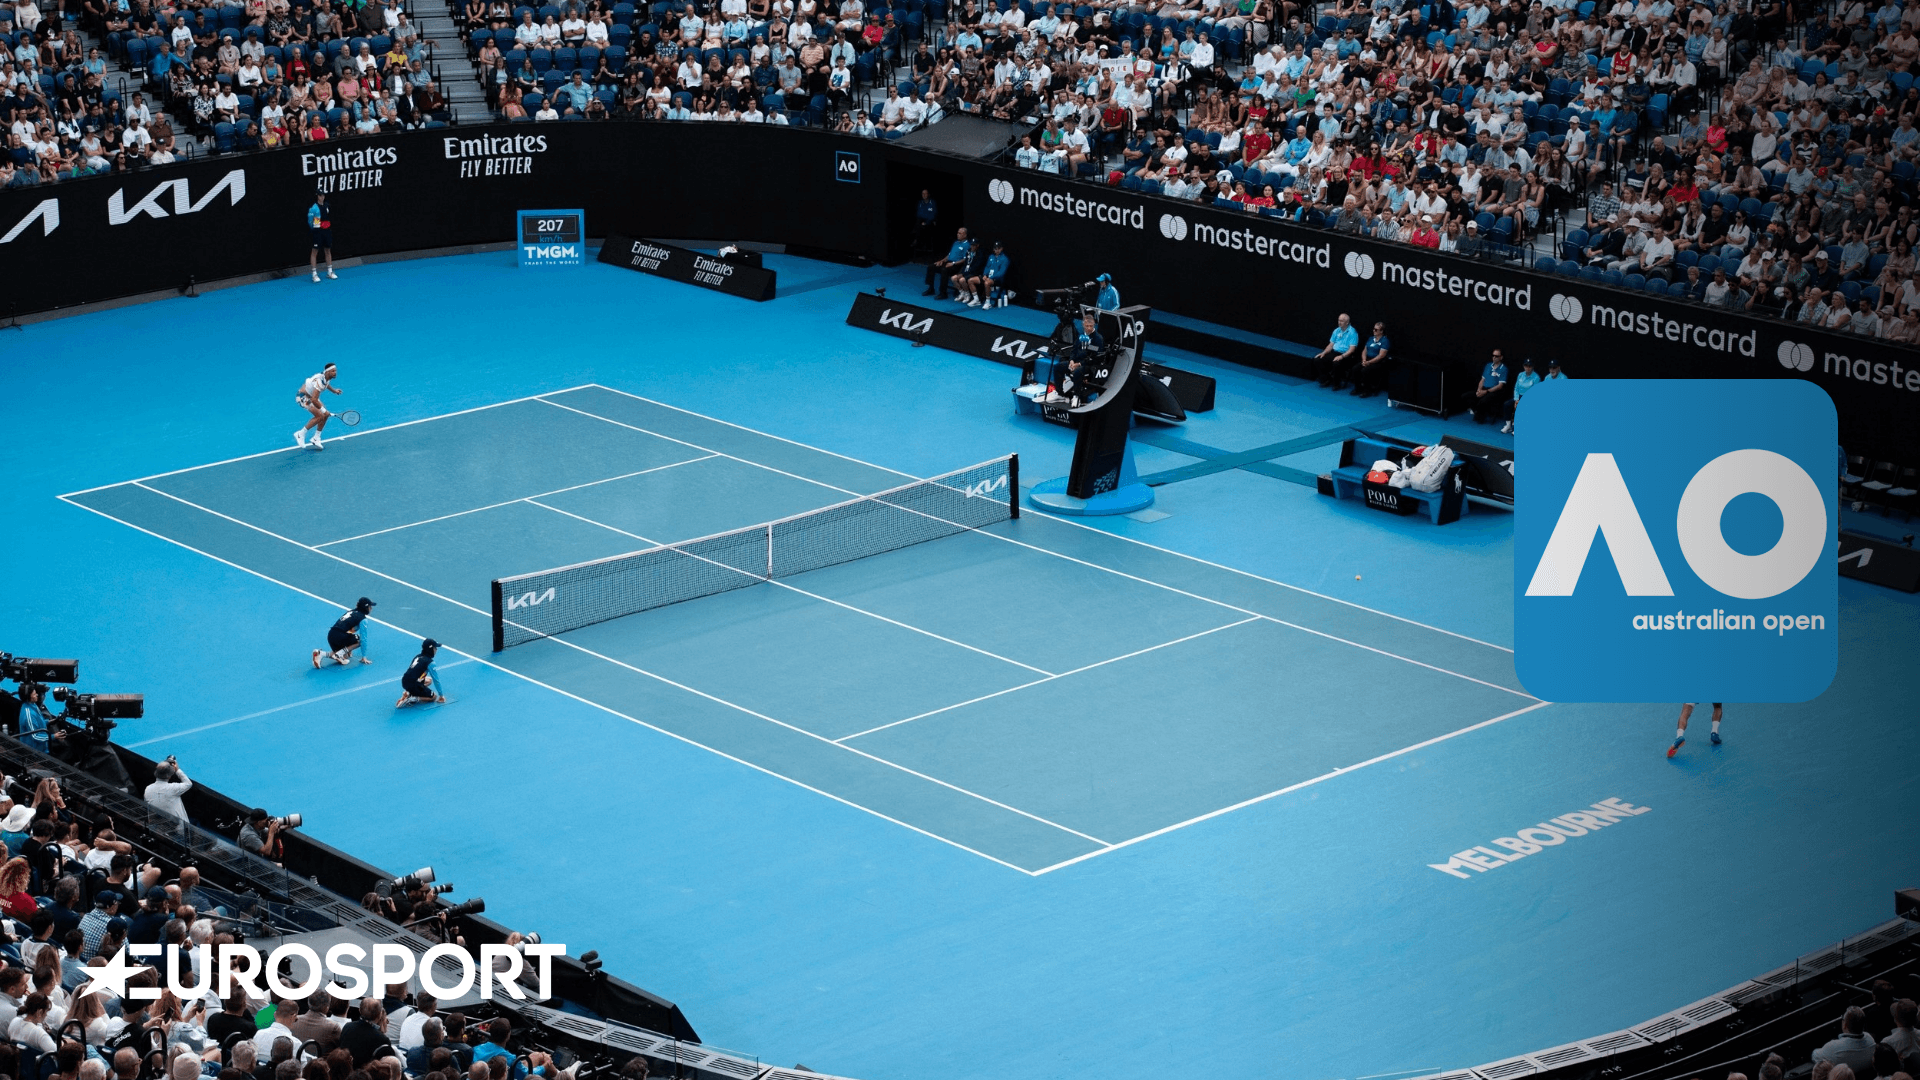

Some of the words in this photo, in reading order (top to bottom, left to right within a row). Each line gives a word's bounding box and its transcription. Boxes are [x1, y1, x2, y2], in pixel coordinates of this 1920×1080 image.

[444, 133, 548, 159] Emirates
[301, 146, 398, 176] Emirates
[460, 159, 482, 178] FLY
[485, 156, 532, 176] BETTER
[317, 174, 336, 194] FLY
[339, 168, 383, 191] BETTER
[108, 169, 246, 225] KIA
[1020, 186, 1144, 230] mastercard
[537, 219, 564, 232] 207
[631, 240, 671, 261] Emirates
[1194, 222, 1330, 269] mastercard
[693, 255, 735, 277] Emirates
[1381, 259, 1532, 311] mastercard
[879, 308, 935, 334] KIA
[1590, 303, 1757, 358] mastercard
[1429, 458, 1446, 477] HEAD
[1367, 489, 1398, 506] POLO
[1426, 797, 1653, 879] MELBOURNE
